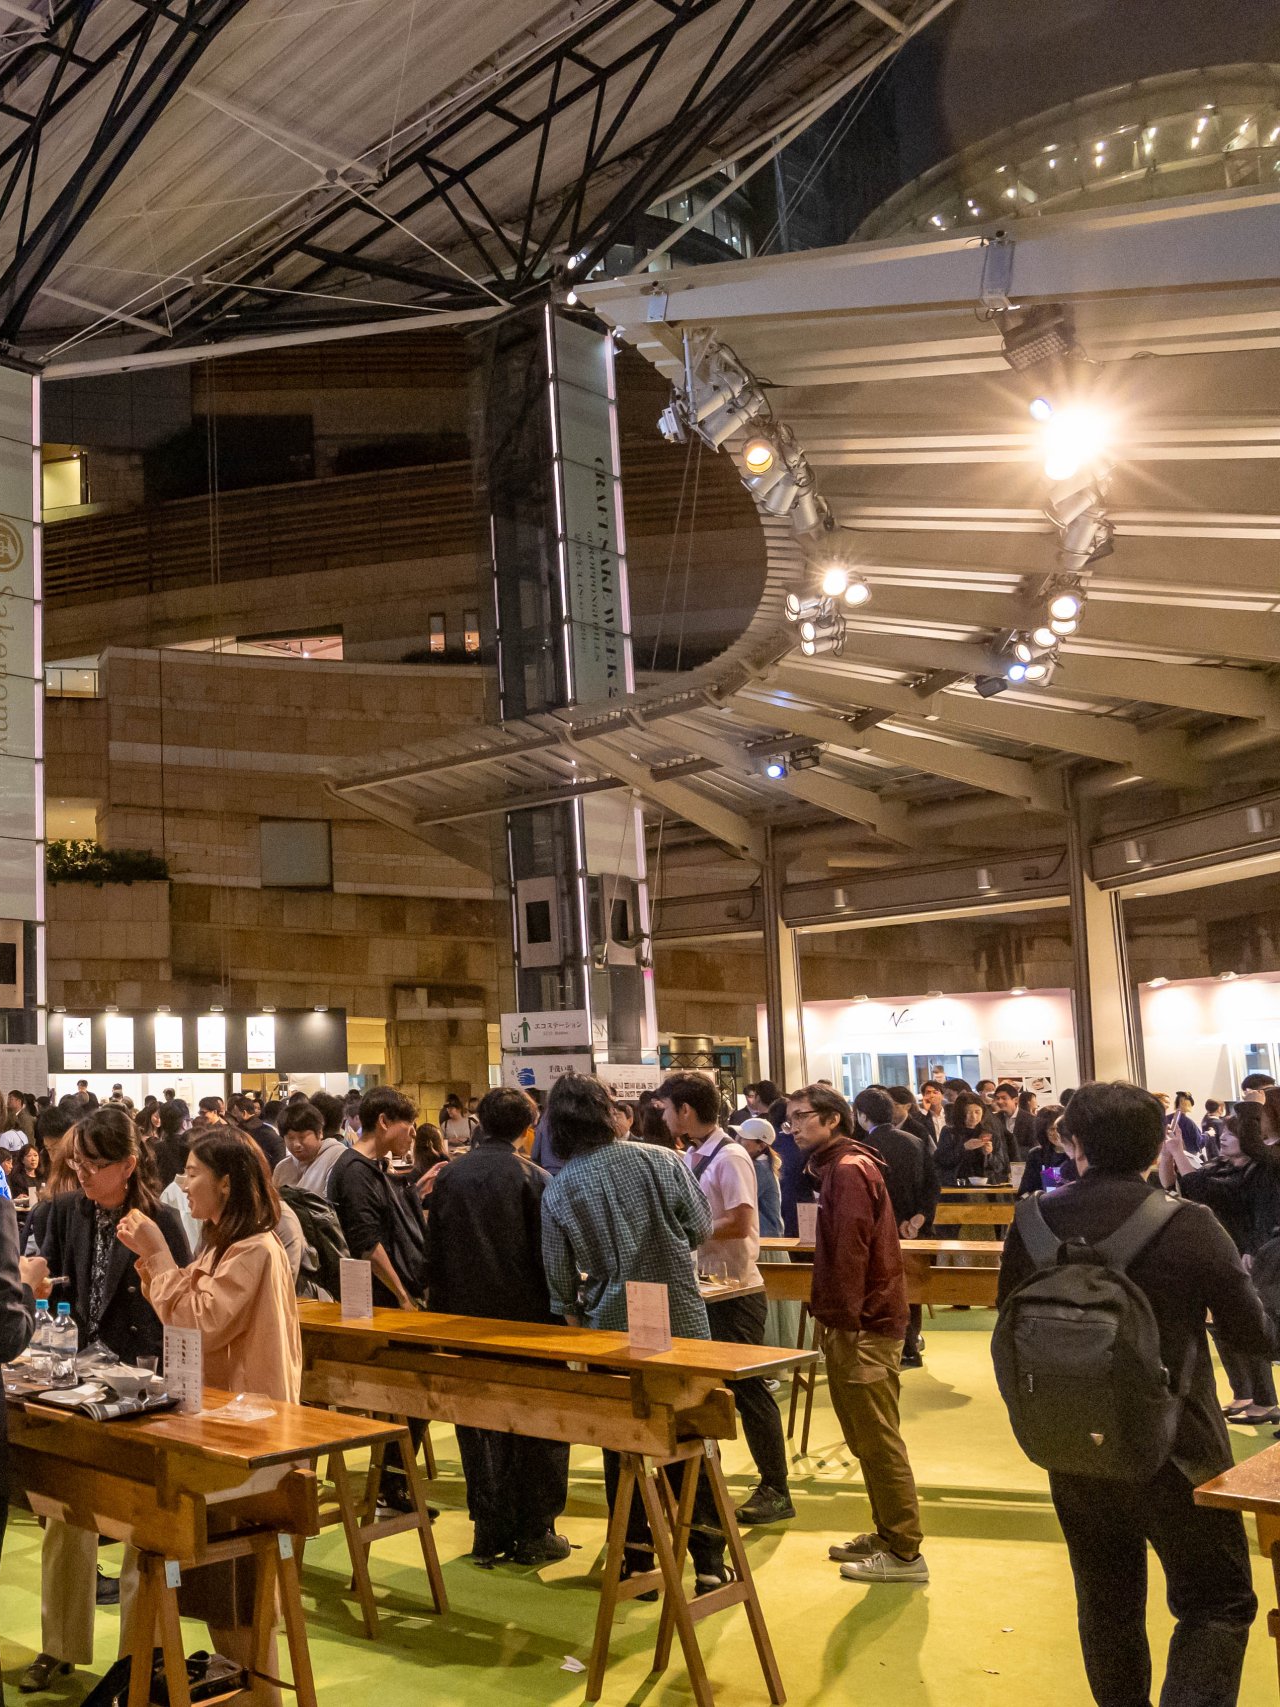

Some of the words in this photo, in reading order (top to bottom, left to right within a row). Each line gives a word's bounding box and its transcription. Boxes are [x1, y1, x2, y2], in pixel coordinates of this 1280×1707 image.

[593, 456, 610, 530] CRAFT
[598, 536, 614, 602] SAKE
[602, 607, 618, 680] WEEK
[534, 1020, 582, 1029] エコステーション
